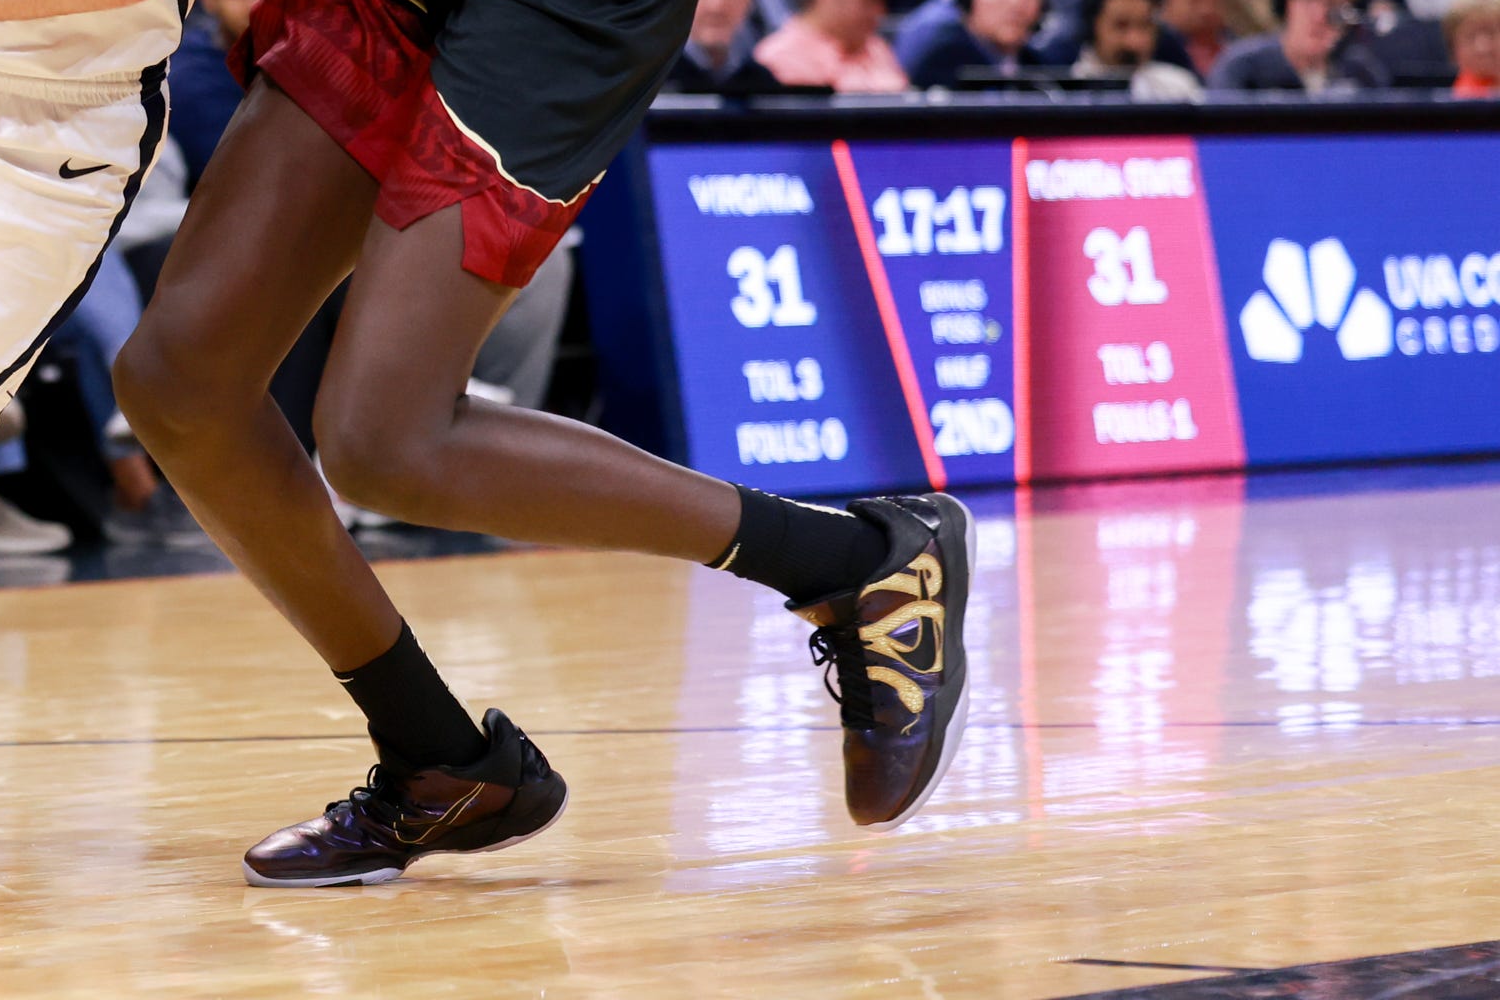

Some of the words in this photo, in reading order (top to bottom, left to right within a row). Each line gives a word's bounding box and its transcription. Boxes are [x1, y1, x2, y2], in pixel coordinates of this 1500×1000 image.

[688, 174, 815, 216] VIRGINIA
[873, 186, 1007, 256] 17:17
[727, 245, 818, 328] 31
[1084, 227, 1169, 306] 31
[742, 360, 799, 402] TOL
[796, 358, 824, 400] 3
[1097, 343, 1150, 384] TOL
[736, 420, 823, 465] FOULS
[931, 399, 1014, 455] 2ND
[1093, 400, 1173, 443] FOULS
